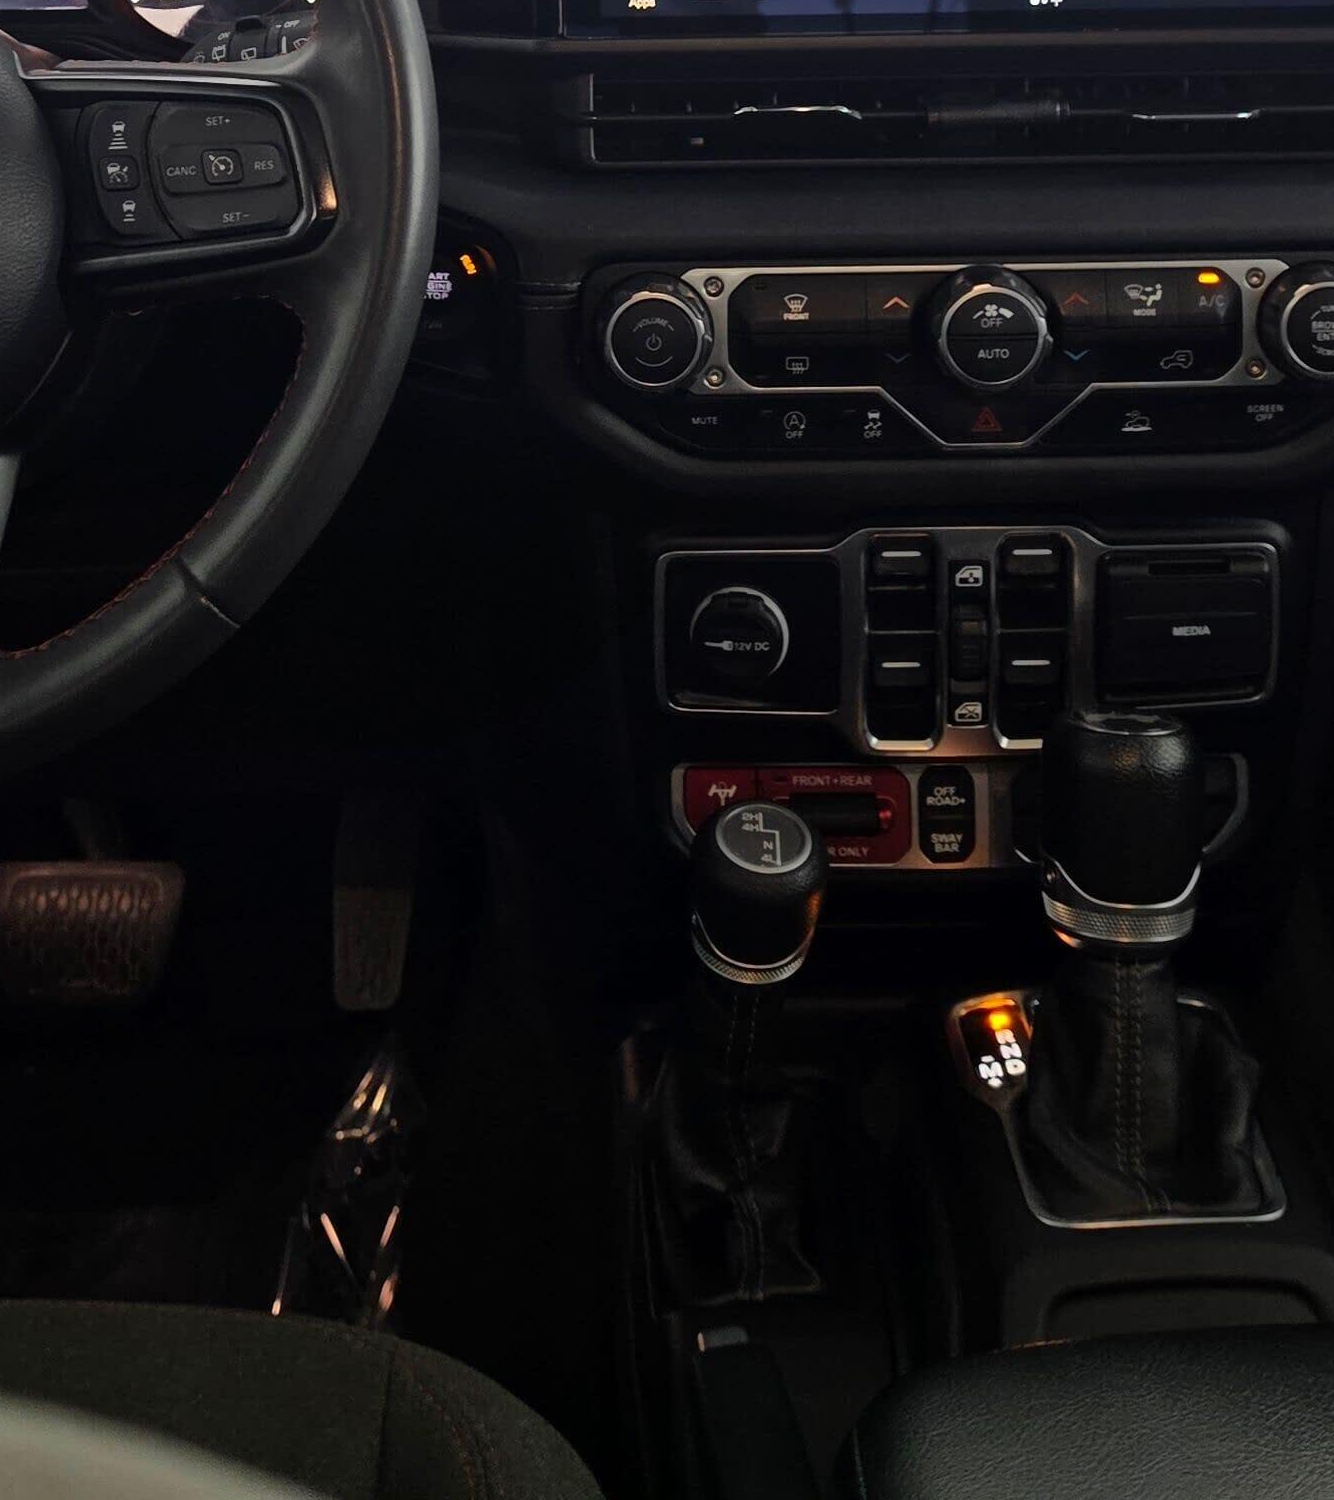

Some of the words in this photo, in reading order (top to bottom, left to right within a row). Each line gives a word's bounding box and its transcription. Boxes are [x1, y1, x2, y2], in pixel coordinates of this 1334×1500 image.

[254, 160, 274, 170] RES
[166, 166, 197, 177] CANC
[1198, 295, 1224, 308] A/C
[783, 312, 810, 321] FRONT
[1133, 308, 1157, 317] MODE
[636, 316, 668, 330] VOLUME
[980, 318, 1003, 328] OFF
[977, 348, 1010, 359] AUTO
[1247, 404, 1285, 414] SCREEN
[691, 416, 719, 426] MUTE
[1255, 413, 1275, 423] OFF
[785, 428, 803, 439] OFF
[863, 428, 882, 439] OFF
[1172, 625, 1211, 636] MEDIA
[734, 642, 753, 651] 12V
[754, 642, 771, 651] DC
[934, 786, 955, 796] OFF
[930, 833, 963, 844] SWAY
[763, 840, 774, 850] N
[934, 843, 960, 853] BAR
[839, 846, 870, 857] ONLY
[1000, 1043, 1022, 1059] N
[1005, 1059, 1026, 1076] D
